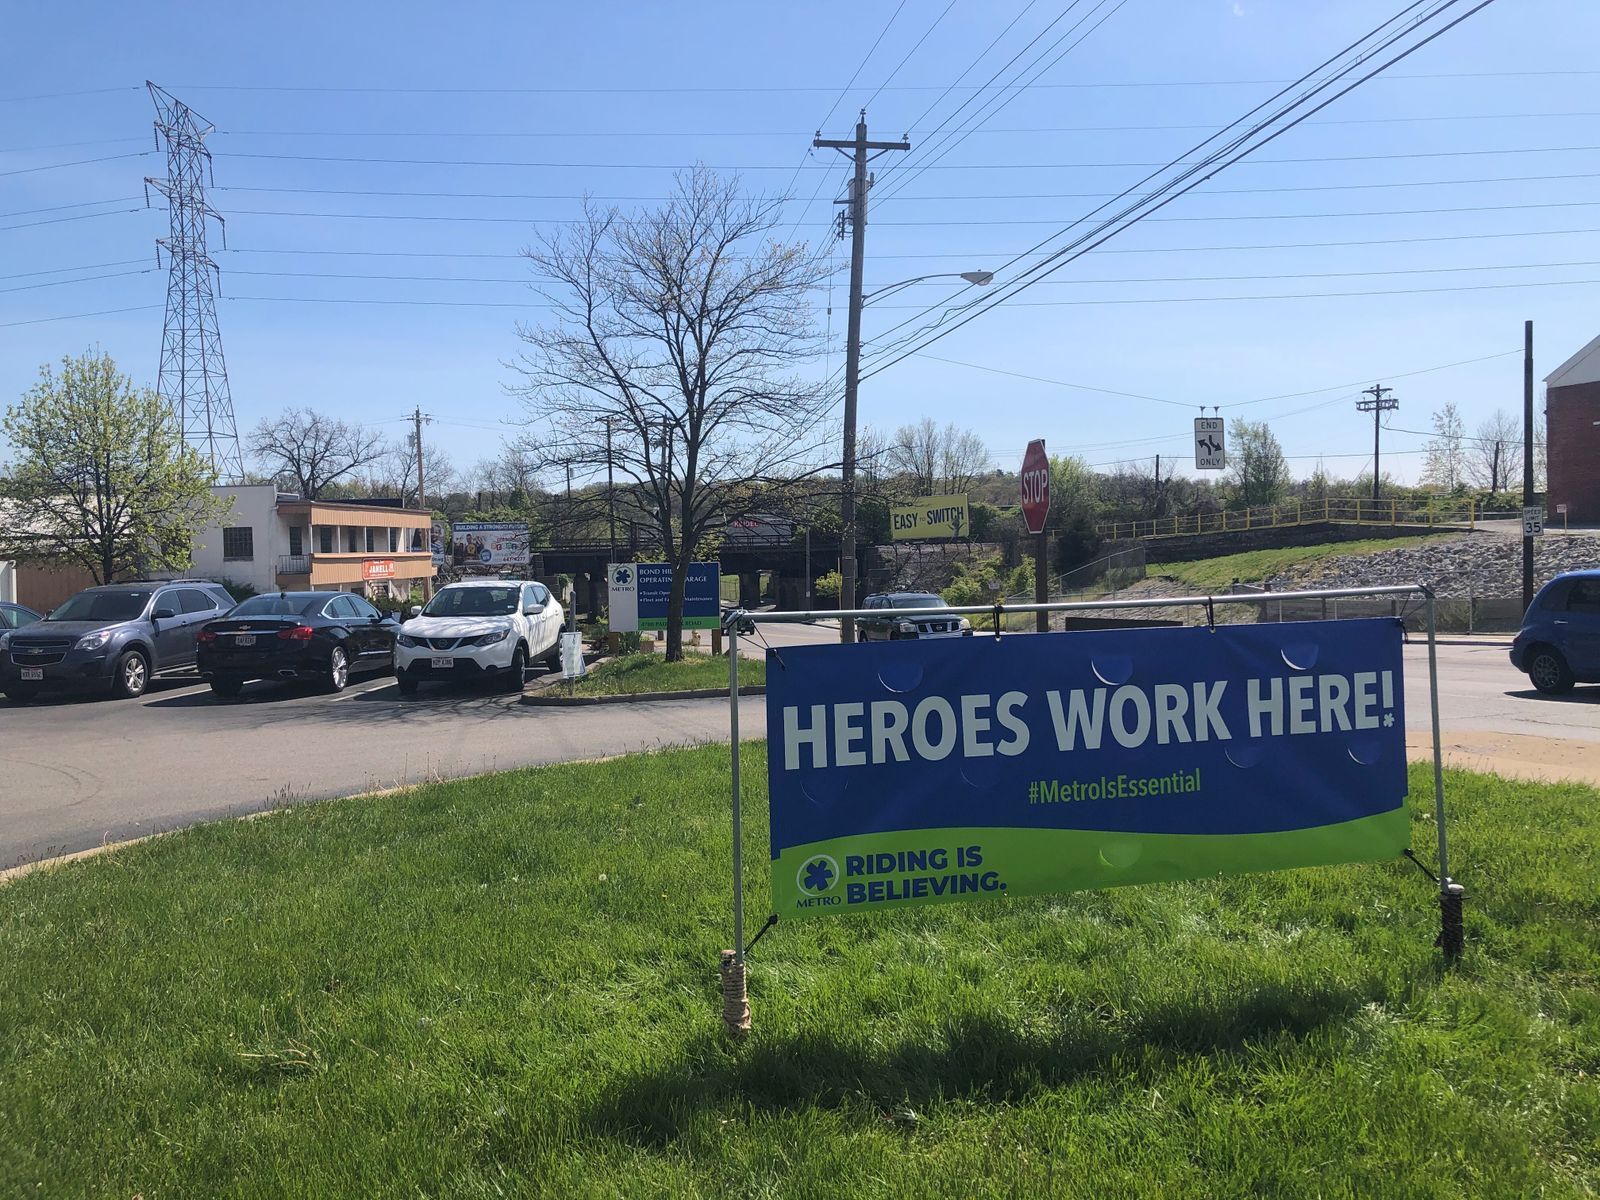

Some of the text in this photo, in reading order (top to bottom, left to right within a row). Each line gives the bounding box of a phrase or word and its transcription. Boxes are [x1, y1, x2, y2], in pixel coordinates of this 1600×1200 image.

[1201, 421, 1217, 429] END
[1200, 458, 1220, 466] ONLY
[1023, 469, 1048, 504] STOP
[893, 512, 918, 530] EASY
[926, 506, 964, 526] SWITCH
[1525, 522, 1541, 533] 35
[639, 568, 661, 576] BOND
[783, 670, 1395, 770] HEROES WORK HERE!
[1028, 768, 1201, 804] #MetroIsEssential
[845, 846, 983, 877] RIDING IS
[846, 871, 1008, 905] BELIEVING.
[796, 895, 842, 909] METRO
